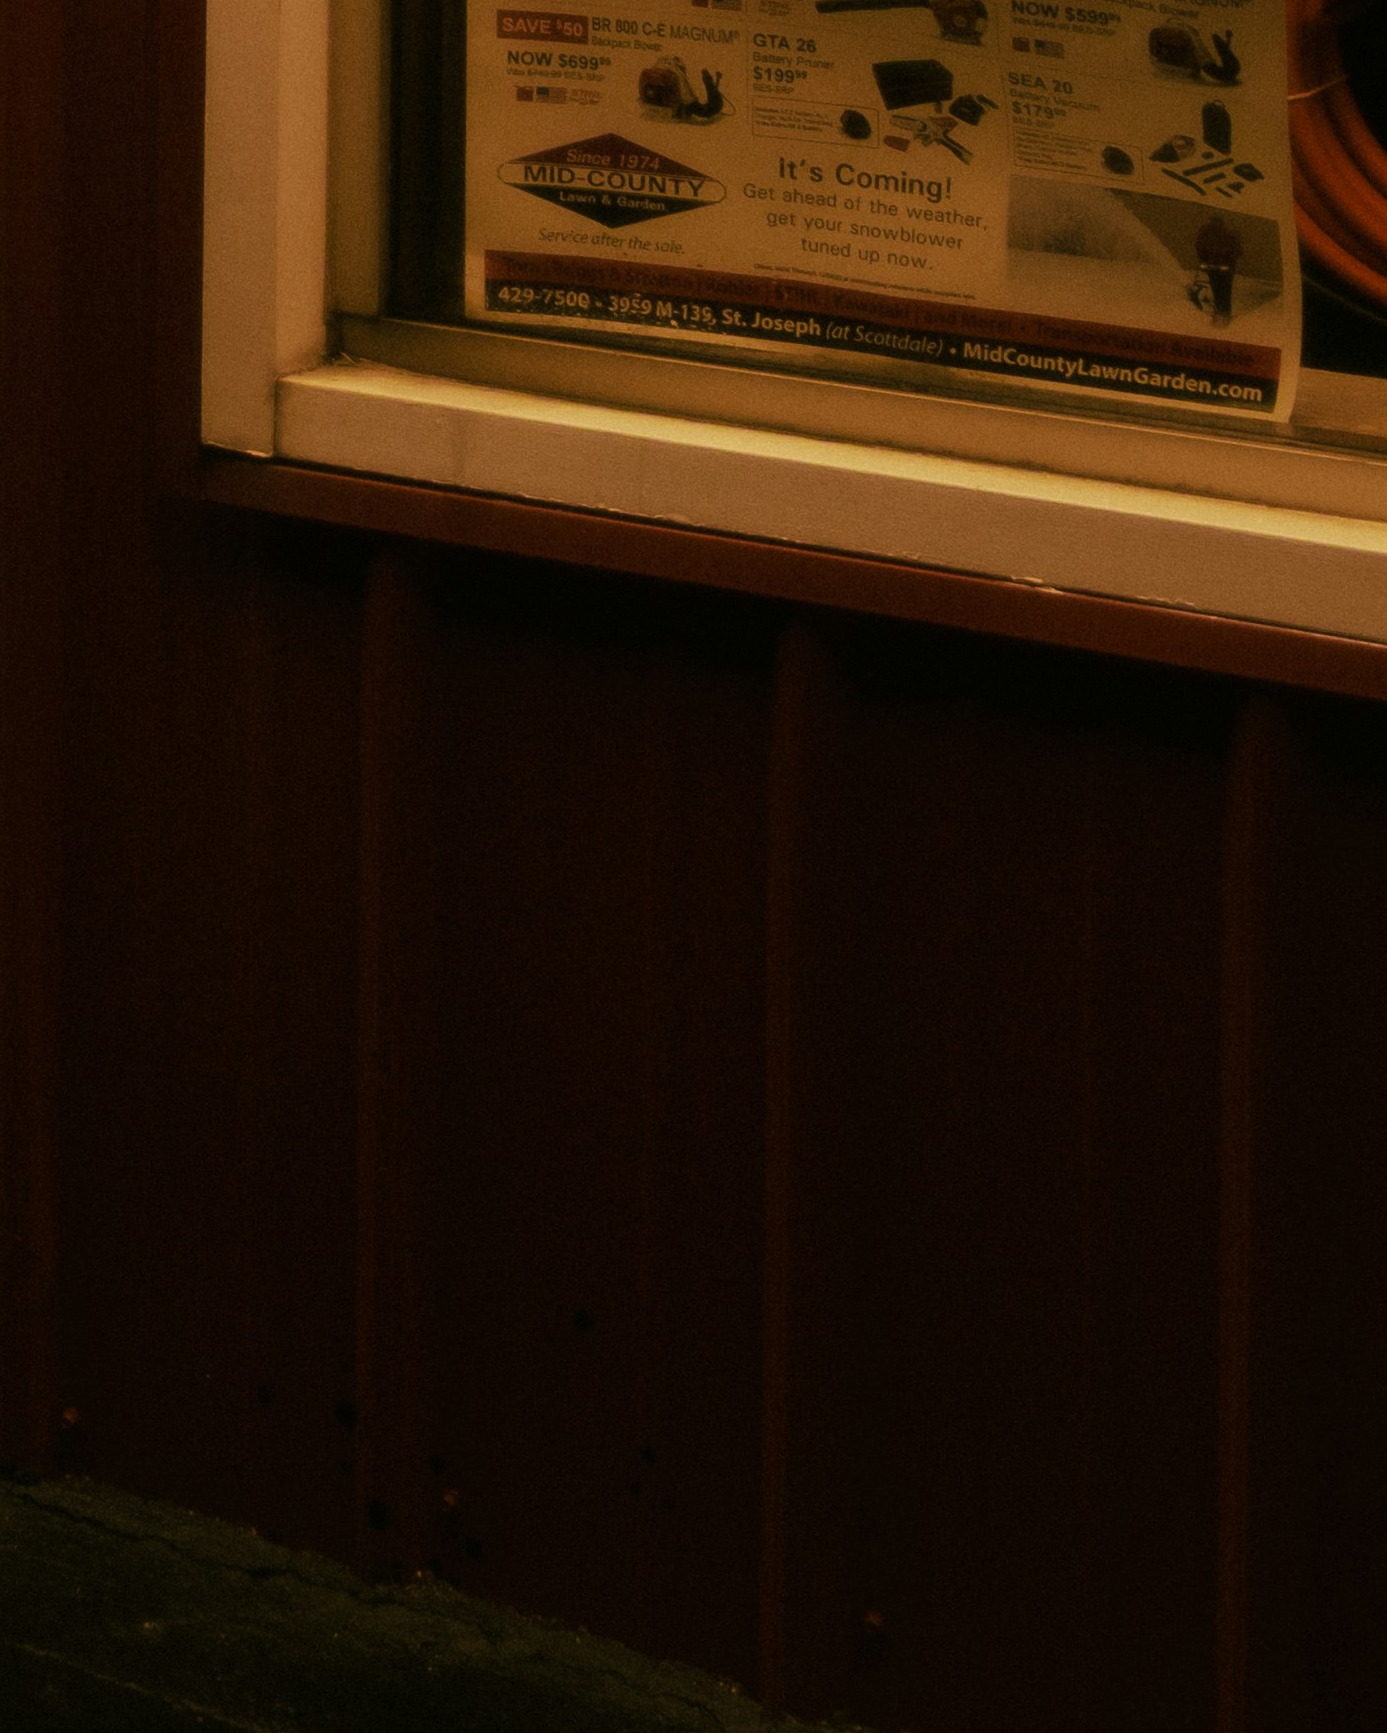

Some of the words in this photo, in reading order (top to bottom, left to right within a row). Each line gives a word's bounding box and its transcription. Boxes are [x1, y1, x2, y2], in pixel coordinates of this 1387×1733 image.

[1011, 0, 1059, 19] NOW
[501, 17, 552, 35] SAVE
[556, 20, 583, 37] $50
[591, 16, 611, 33] BR
[642, 21, 665, 38] C-E
[753, 33, 791, 50] GTA
[796, 37, 817, 54] 26
[507, 50, 553, 67] NOW
[752, 51, 792, 67] Battery
[796, 55, 835, 70] Pruner
[1008, 71, 1047, 90] SEA
[1051, 78, 1074, 95] 20
[1010, 87, 1050, 104] Battery
[565, 148, 611, 166] Since
[618, 153, 661, 171] 1974
[524, 165, 706, 198] MID-COUNTY
[834, 162, 953, 204] Coming!
[559, 190, 597, 205] Lawn
[601, 193, 612, 206] &
[616, 196, 666, 212] Garden
[742, 182, 776, 201] Get
[782, 187, 838, 208] ahead
[843, 196, 862, 211] of
[869, 199, 899, 217] the
[906, 206, 989, 232] weather,
[538, 228, 588, 244] Service
[590, 231, 625, 250] after
[627, 233, 651, 251] the
[654, 236, 686, 255] sale.
[766, 211, 796, 227] get
[803, 216, 843, 232] your
[850, 221, 965, 250] snowblower
[800, 237, 852, 258] tuned
[858, 249, 881, 264] up
[886, 251, 934, 271] now.
[497, 285, 591, 309] 429-7500
[608, 293, 652, 315] 3959
[722, 309, 747, 328] St.
[751, 311, 822, 337] Joseph
[826, 321, 850, 341] (at
[854, 323, 944, 357] Scottdale)
[963, 341, 1263, 403] MidCountyLawnGarden.com
